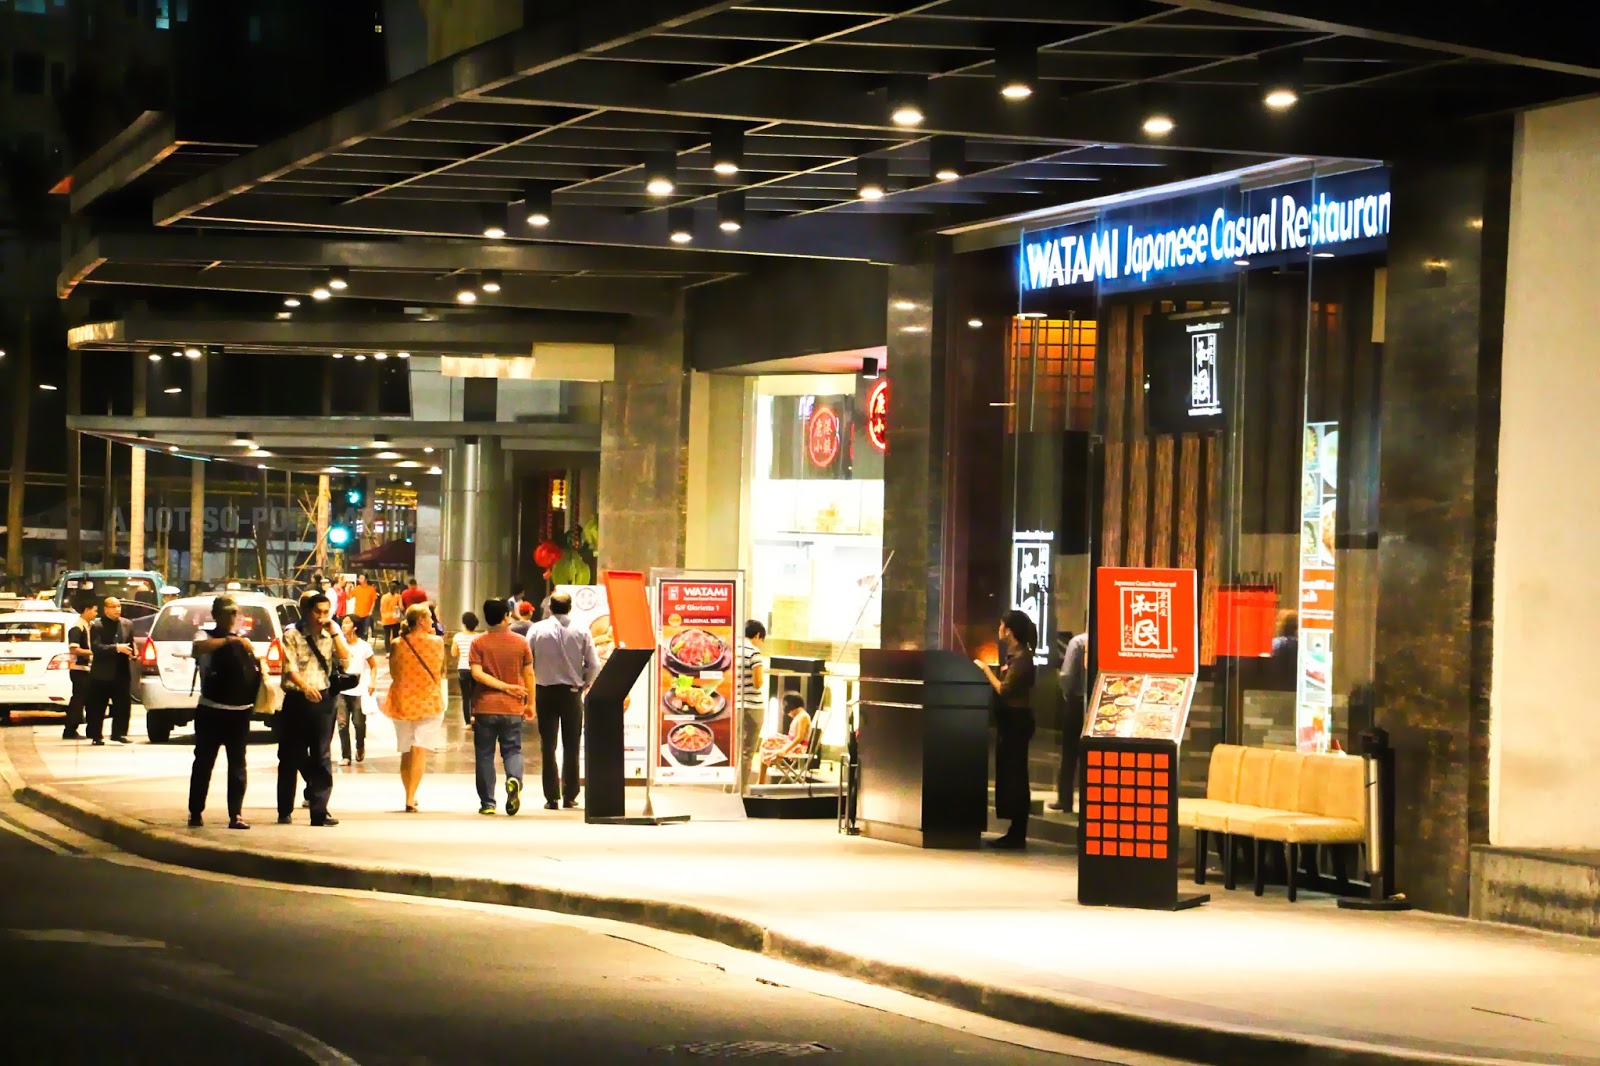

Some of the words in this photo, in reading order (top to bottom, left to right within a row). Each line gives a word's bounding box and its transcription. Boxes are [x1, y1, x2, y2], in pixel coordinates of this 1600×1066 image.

[1026, 229, 1118, 289] WATAMI
[1124, 223, 1209, 282] Japanese
[1211, 197, 1277, 263] Casual
[683, 587, 728, 597] WATAMI
